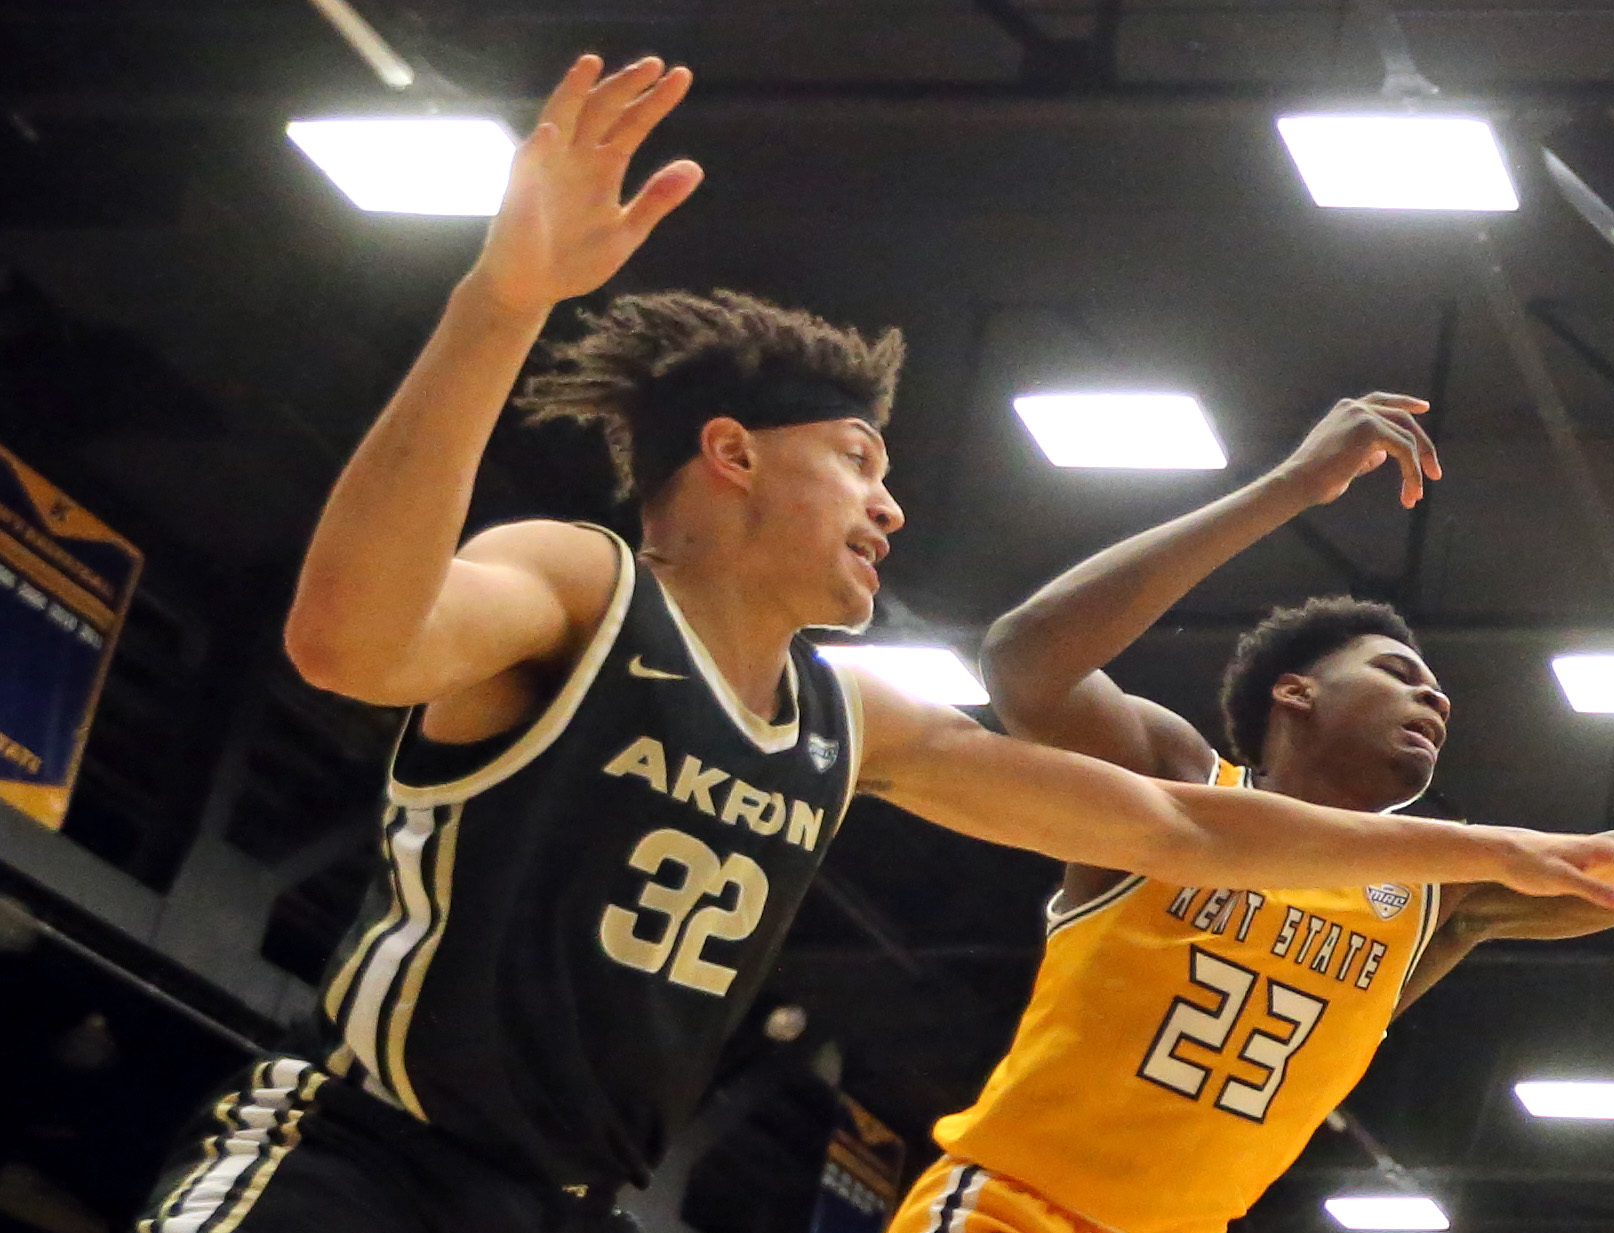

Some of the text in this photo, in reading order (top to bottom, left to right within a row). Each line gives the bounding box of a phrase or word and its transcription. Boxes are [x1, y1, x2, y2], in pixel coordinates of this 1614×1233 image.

[601, 828, 770, 997] 32
[1271, 905, 1388, 991] STATE
[1136, 943, 1330, 1125] 23
